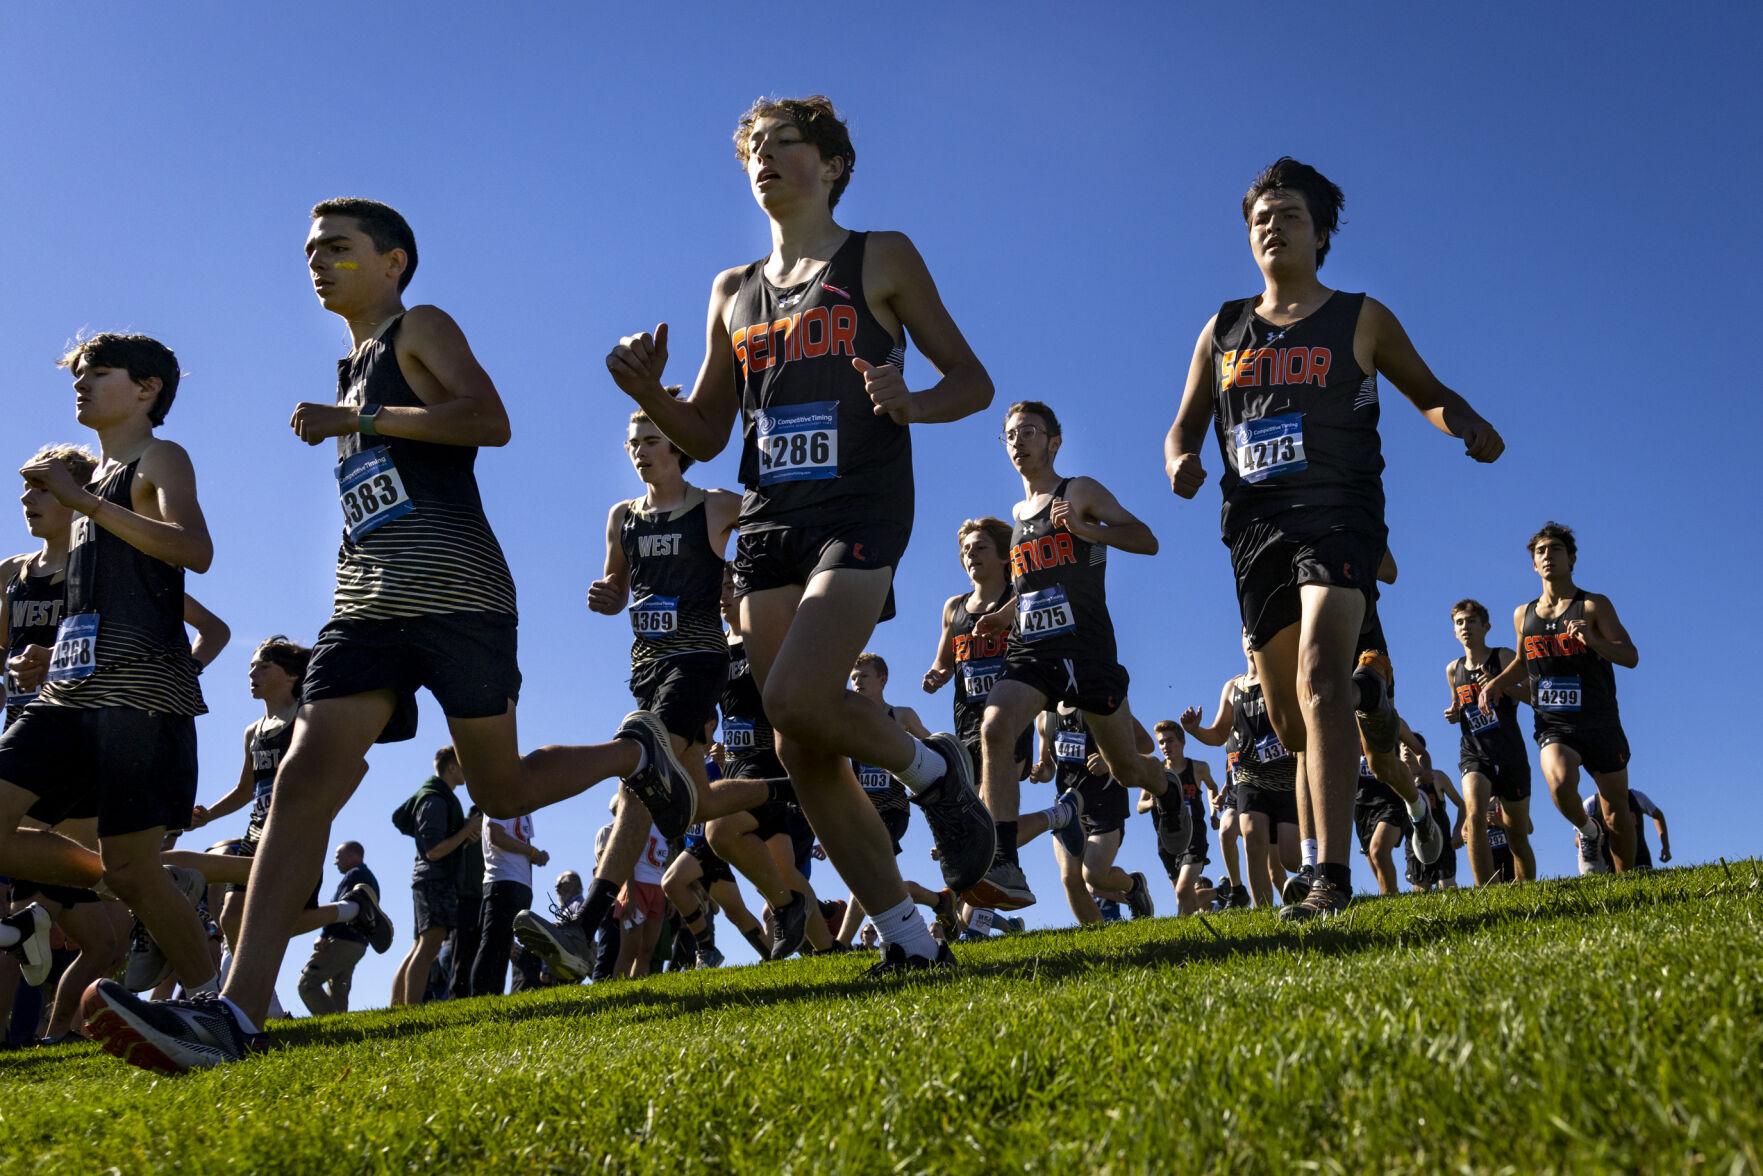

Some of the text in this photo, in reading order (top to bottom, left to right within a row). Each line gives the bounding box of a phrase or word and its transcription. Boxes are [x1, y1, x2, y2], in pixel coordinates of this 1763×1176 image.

[732, 305, 857, 381] SENIOR
[1221, 346, 1332, 391] SENIOR
[762, 432, 830, 470] 4286
[1244, 436, 1296, 471] 4273
[638, 534, 682, 558] WEST
[12, 600, 64, 628] WEST
[632, 611, 673, 631] 4369
[1024, 605, 1068, 632] 4275
[53, 638, 91, 668] 4368
[967, 673, 1001, 697] 430
[1541, 690, 1578, 705] 4299
[1058, 742, 1081, 758] 4411
